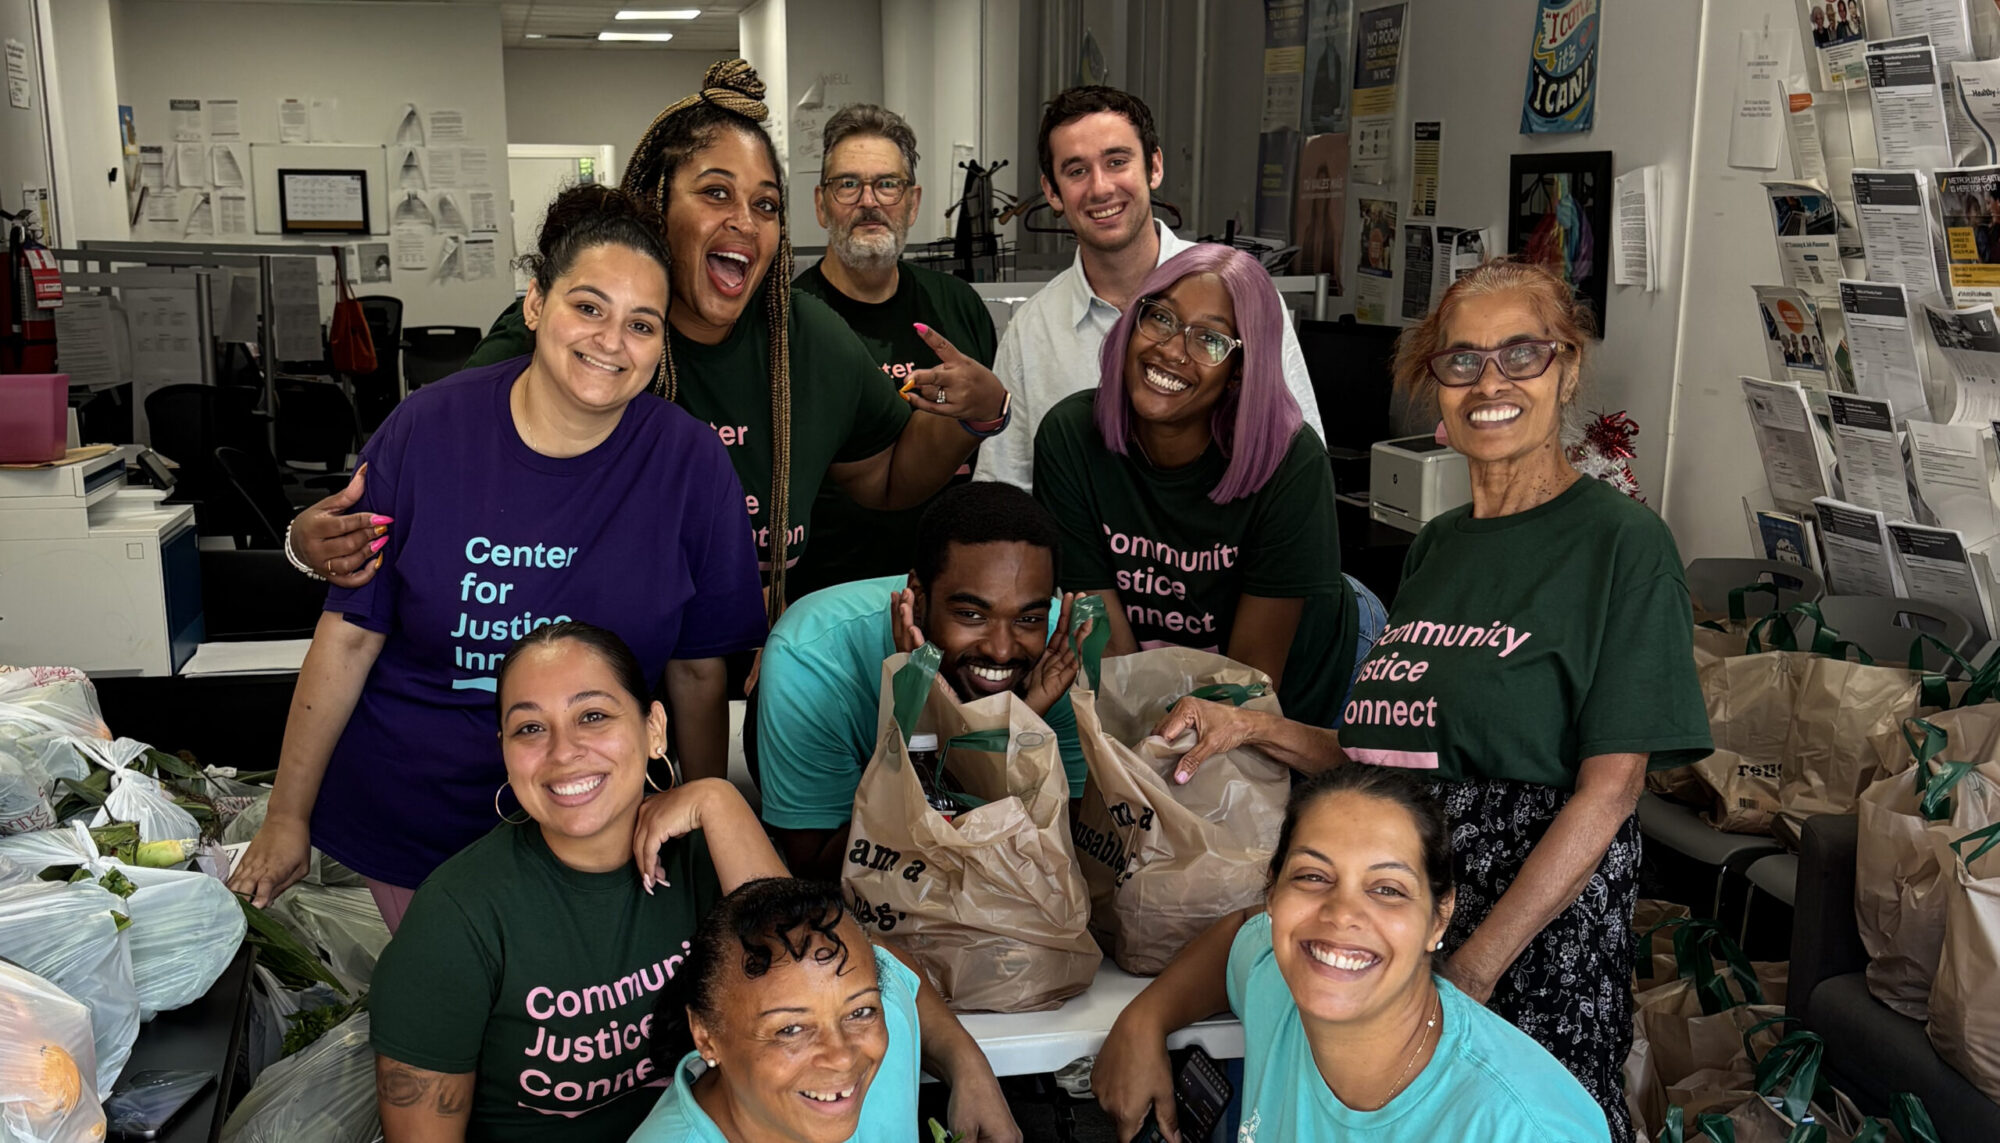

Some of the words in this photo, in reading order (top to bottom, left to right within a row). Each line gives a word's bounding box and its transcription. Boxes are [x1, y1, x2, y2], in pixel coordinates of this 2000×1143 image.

[881, 362, 915, 379] ter
[465, 536, 578, 569] Center
[1103, 523, 1239, 572] ommunit
[460, 572, 514, 604] for
[1116, 566, 1186, 600] stice
[1126, 604, 1216, 634] nnect
[1379, 620, 1532, 658] ommunity
[1355, 652, 1429, 684] stice
[1344, 696, 1438, 728] onnect
[1139, 806, 1154, 831] a
[849, 839, 901, 871] am
[903, 860, 926, 882] a
[519, 1057, 655, 1101] Conne
